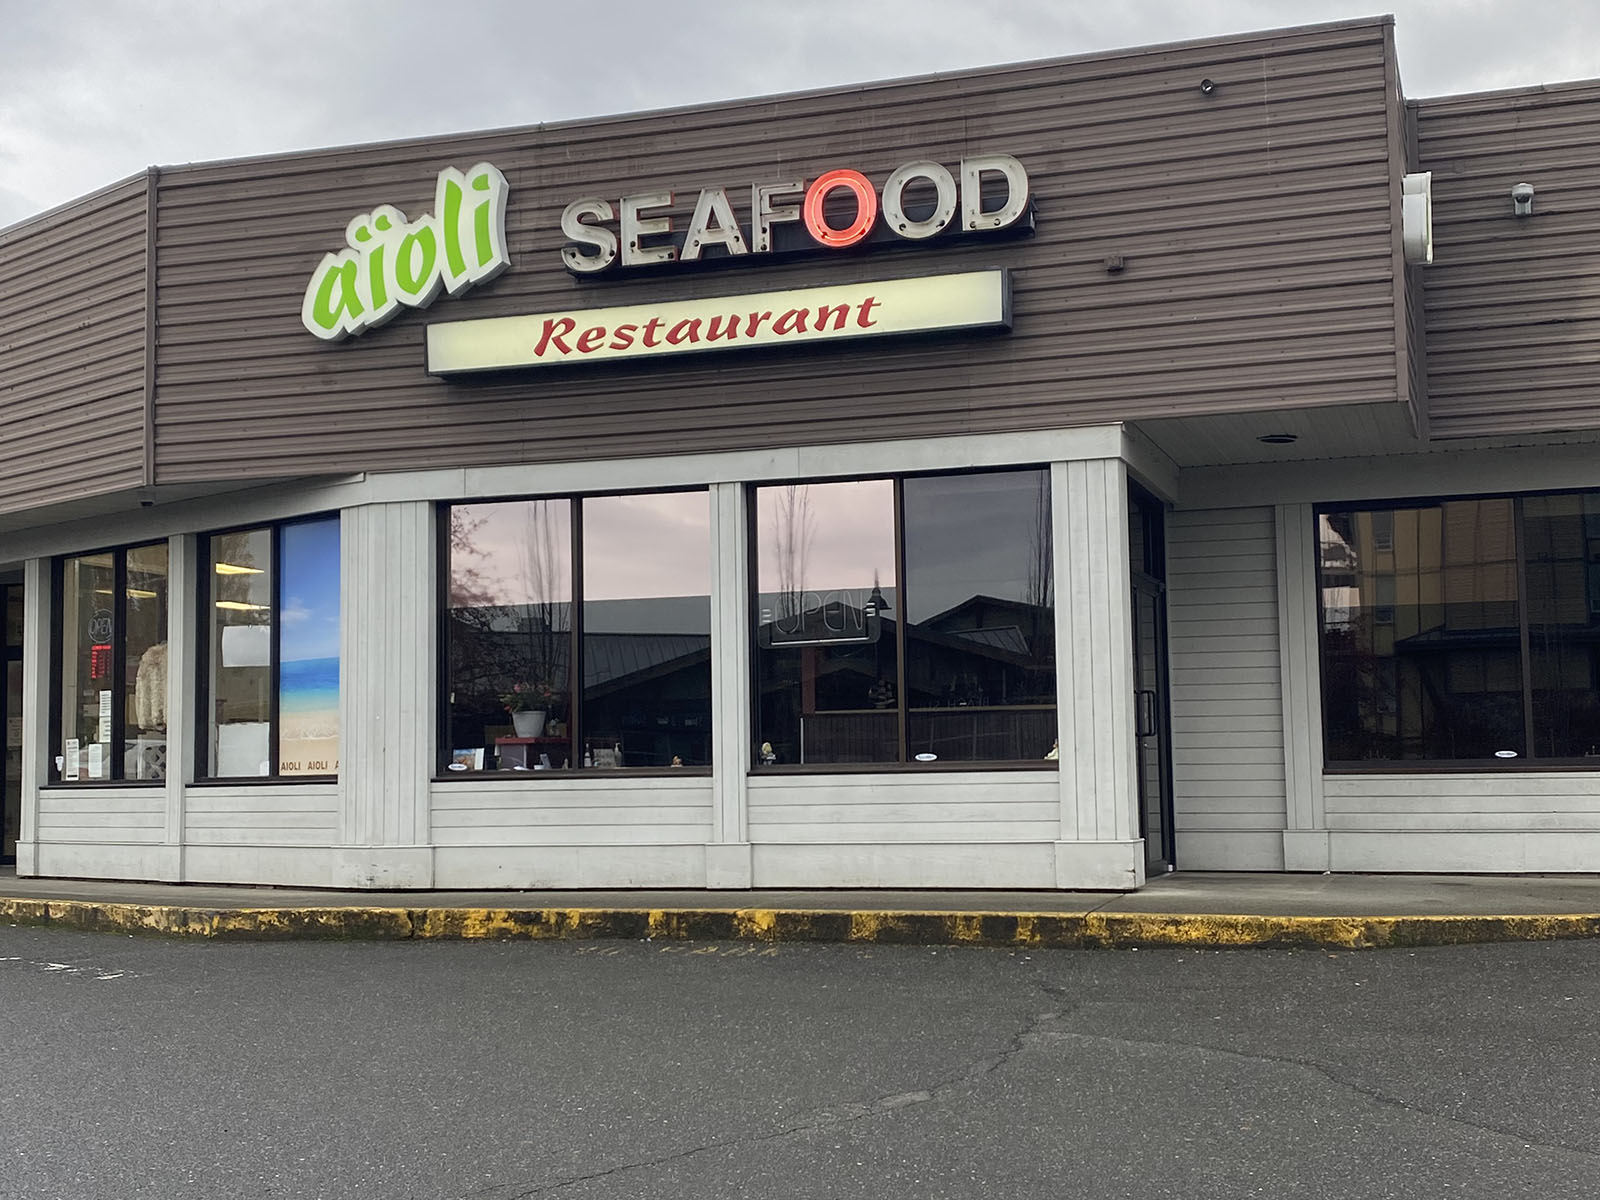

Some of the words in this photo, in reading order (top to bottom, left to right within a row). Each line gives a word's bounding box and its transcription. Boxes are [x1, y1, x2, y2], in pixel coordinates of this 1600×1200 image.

[561, 154, 1030, 273] SEAFOOD
[533, 296, 881, 357] Restaurant
[774, 591, 864, 634] OPEN
[281, 761, 301, 771] AIOLI
[308, 760, 328, 770] AIOLI
